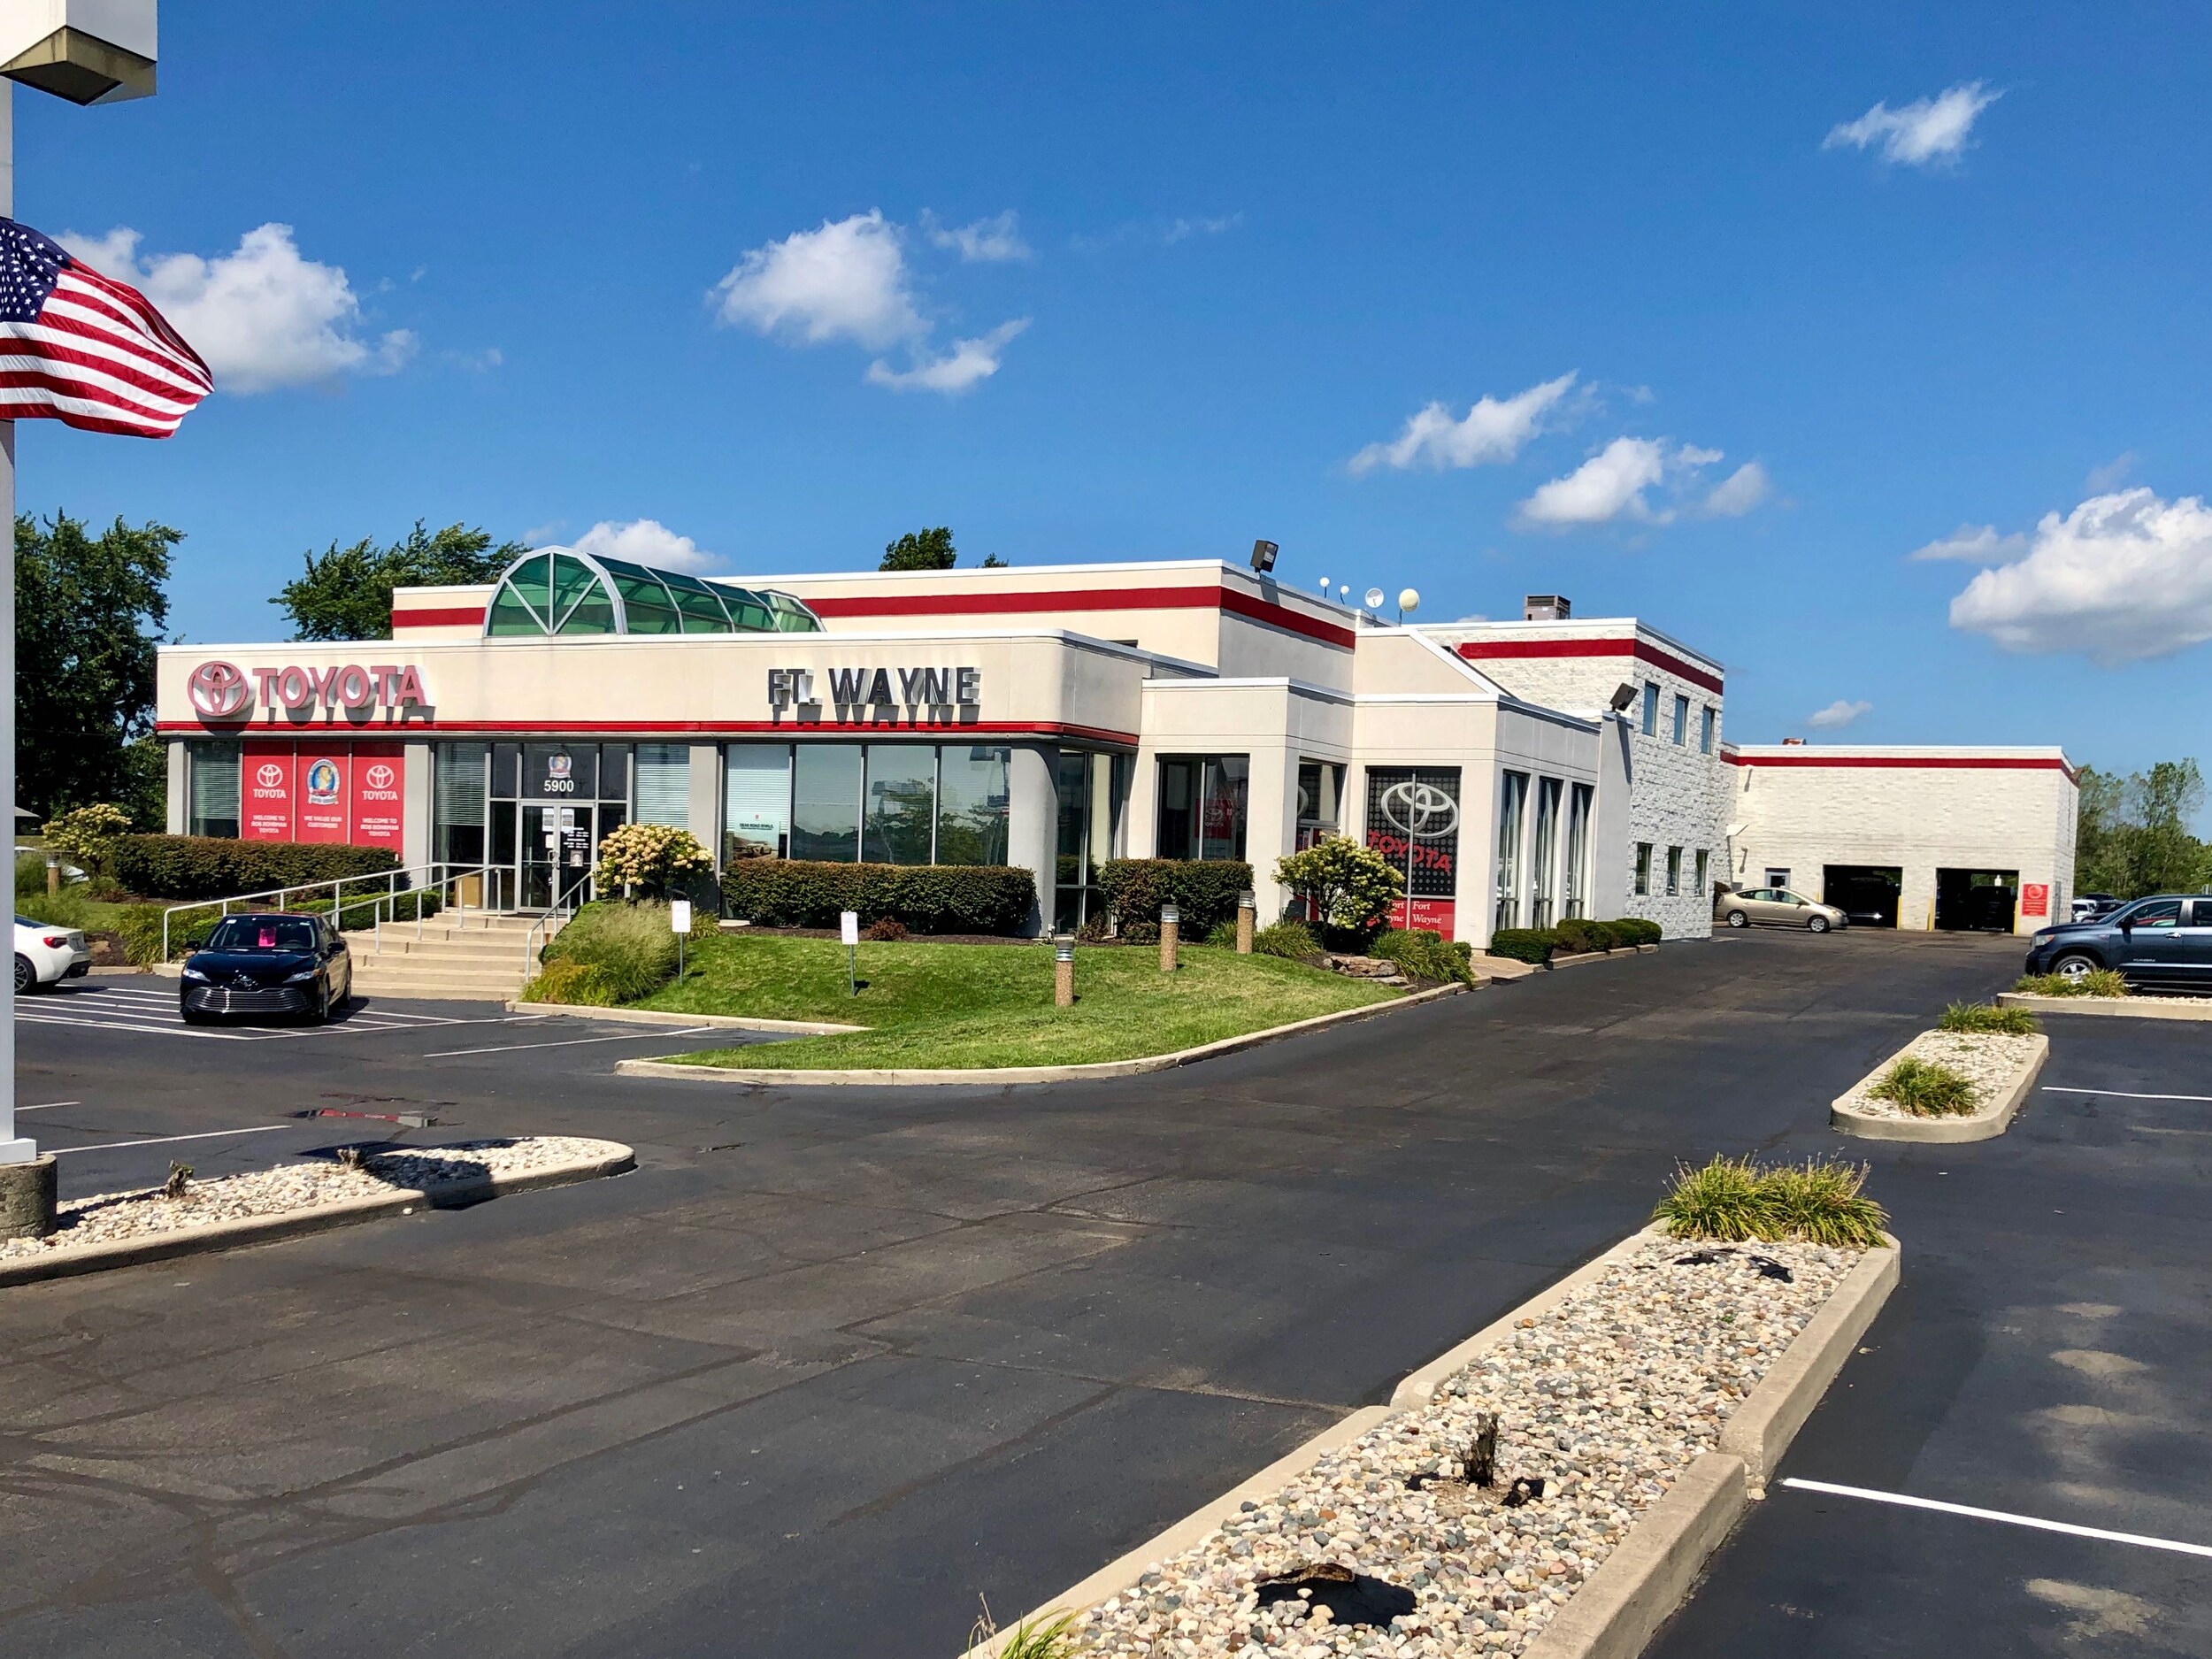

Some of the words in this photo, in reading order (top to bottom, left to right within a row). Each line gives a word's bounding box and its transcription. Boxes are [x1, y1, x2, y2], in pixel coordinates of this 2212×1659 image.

[253, 664, 426, 708] TOYOTA
[828, 667, 976, 705] WAYNE
[544, 780, 574, 792] 5900
[253, 788, 287, 799] TOYOTA
[362, 790, 398, 801] TOYOTA
[1412, 901, 1431, 910] Fort
[1412, 913, 1441, 926] Wayne
